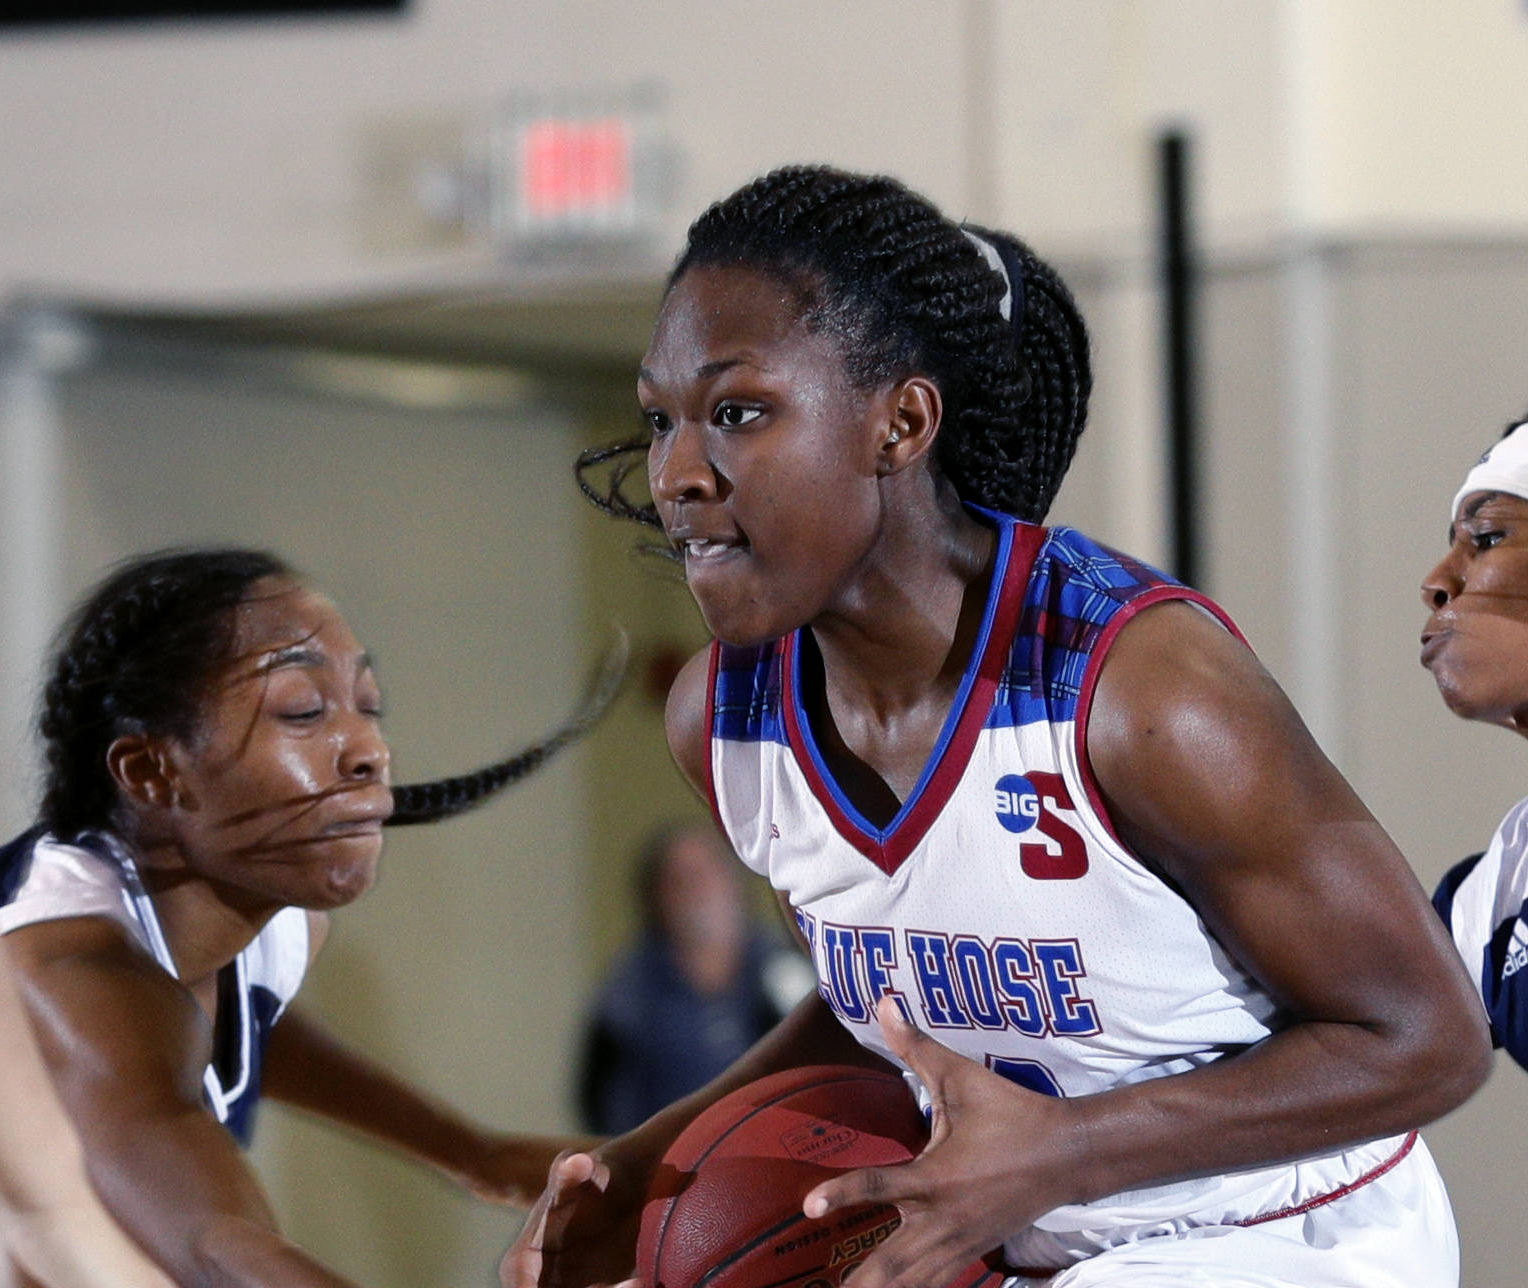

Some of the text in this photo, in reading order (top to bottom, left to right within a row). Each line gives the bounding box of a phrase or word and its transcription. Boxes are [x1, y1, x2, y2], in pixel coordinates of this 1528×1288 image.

[993, 788, 1039, 818] BIG
[904, 927, 1104, 1039] HOSE
[828, 1215, 903, 1268] EGACY
